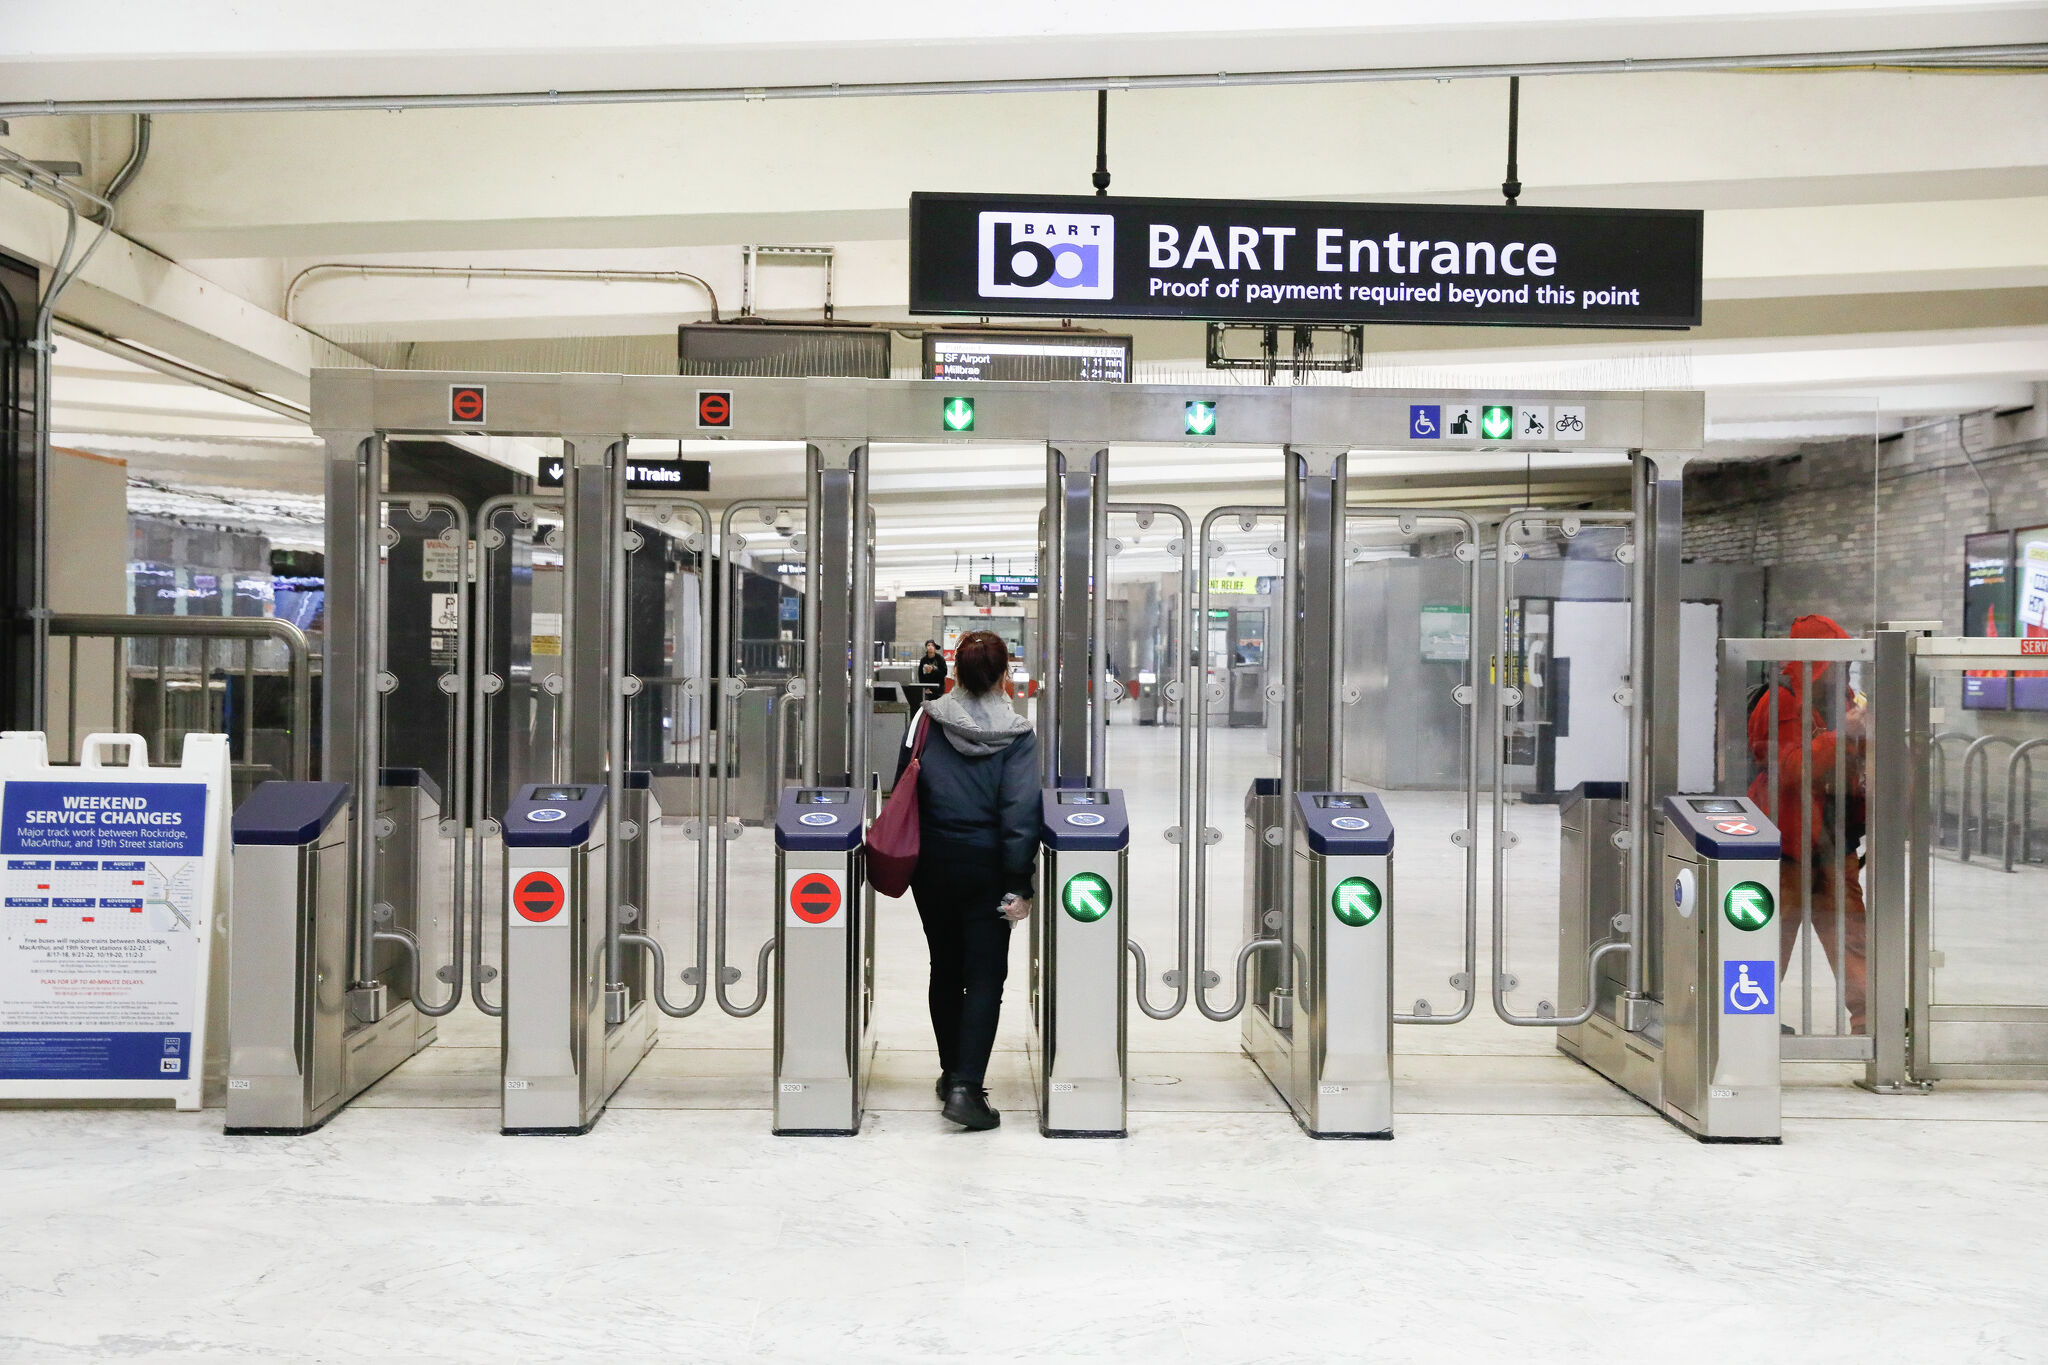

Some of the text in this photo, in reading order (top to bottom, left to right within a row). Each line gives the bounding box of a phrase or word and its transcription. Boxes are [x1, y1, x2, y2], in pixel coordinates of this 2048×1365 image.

[1024, 223, 1101, 237] BART
[1148, 224, 1558, 277] BART Entrance
[1149, 277, 1640, 309] Proof of payment required beyond this point
[944, 353, 991, 365] SF Airport
[1082, 357, 1122, 367] 1, 11 min
[944, 364, 980, 375] Millbrae
[1080, 368, 1122, 379] 4, 21 min
[625, 466, 681, 482] ll Trains
[1221, 580, 1244, 590] RELIEF
[63, 796, 147, 810] WEEKEND
[25, 810, 183, 825] SERVICE CHANGES
[17, 827, 188, 841] Major track work between Rockridge,
[21, 838, 184, 849] MacArthur, and 19th Street stations
